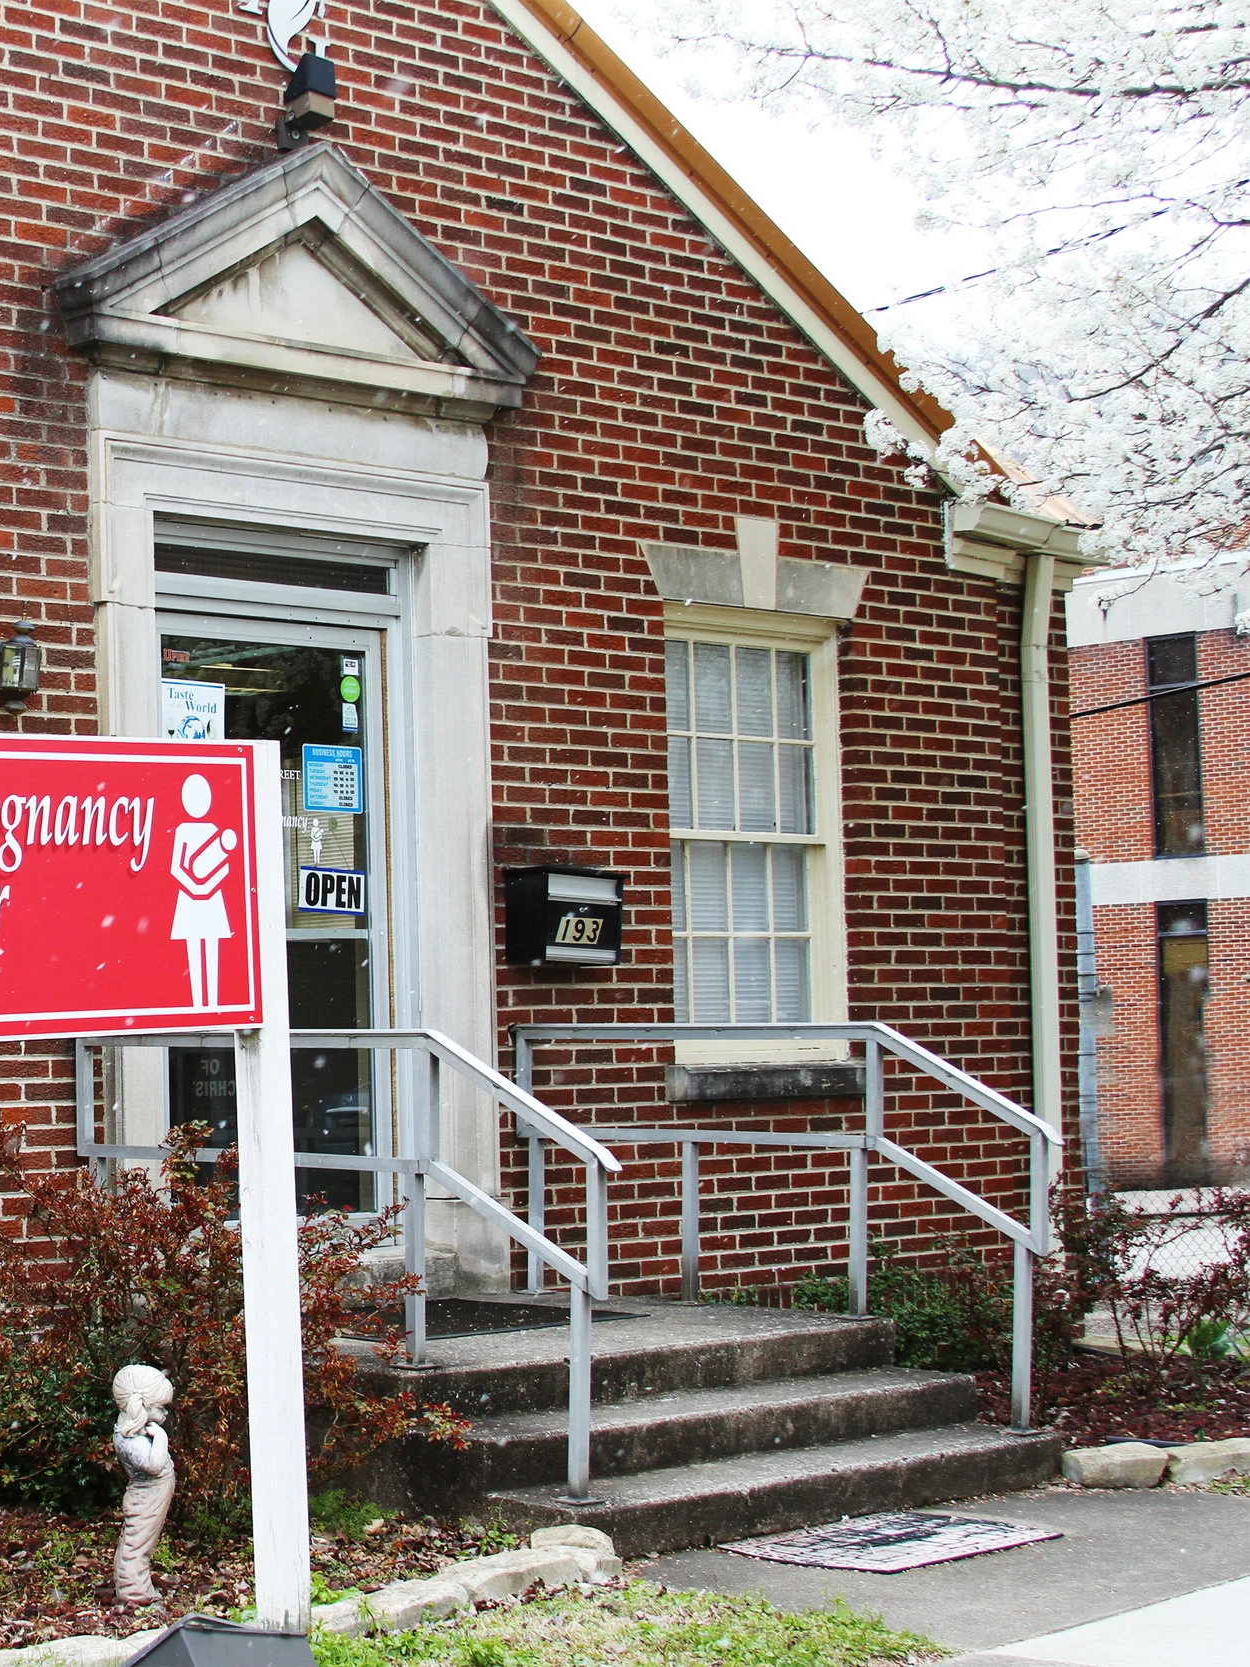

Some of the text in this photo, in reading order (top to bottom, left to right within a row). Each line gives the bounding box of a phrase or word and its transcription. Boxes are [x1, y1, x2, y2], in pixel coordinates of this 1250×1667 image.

[167, 687, 194, 700] Taste
[185, 700, 217, 713] World
[280, 769, 301, 780] REET
[305, 872, 361, 909] OPEN
[561, 919, 600, 942] 193
